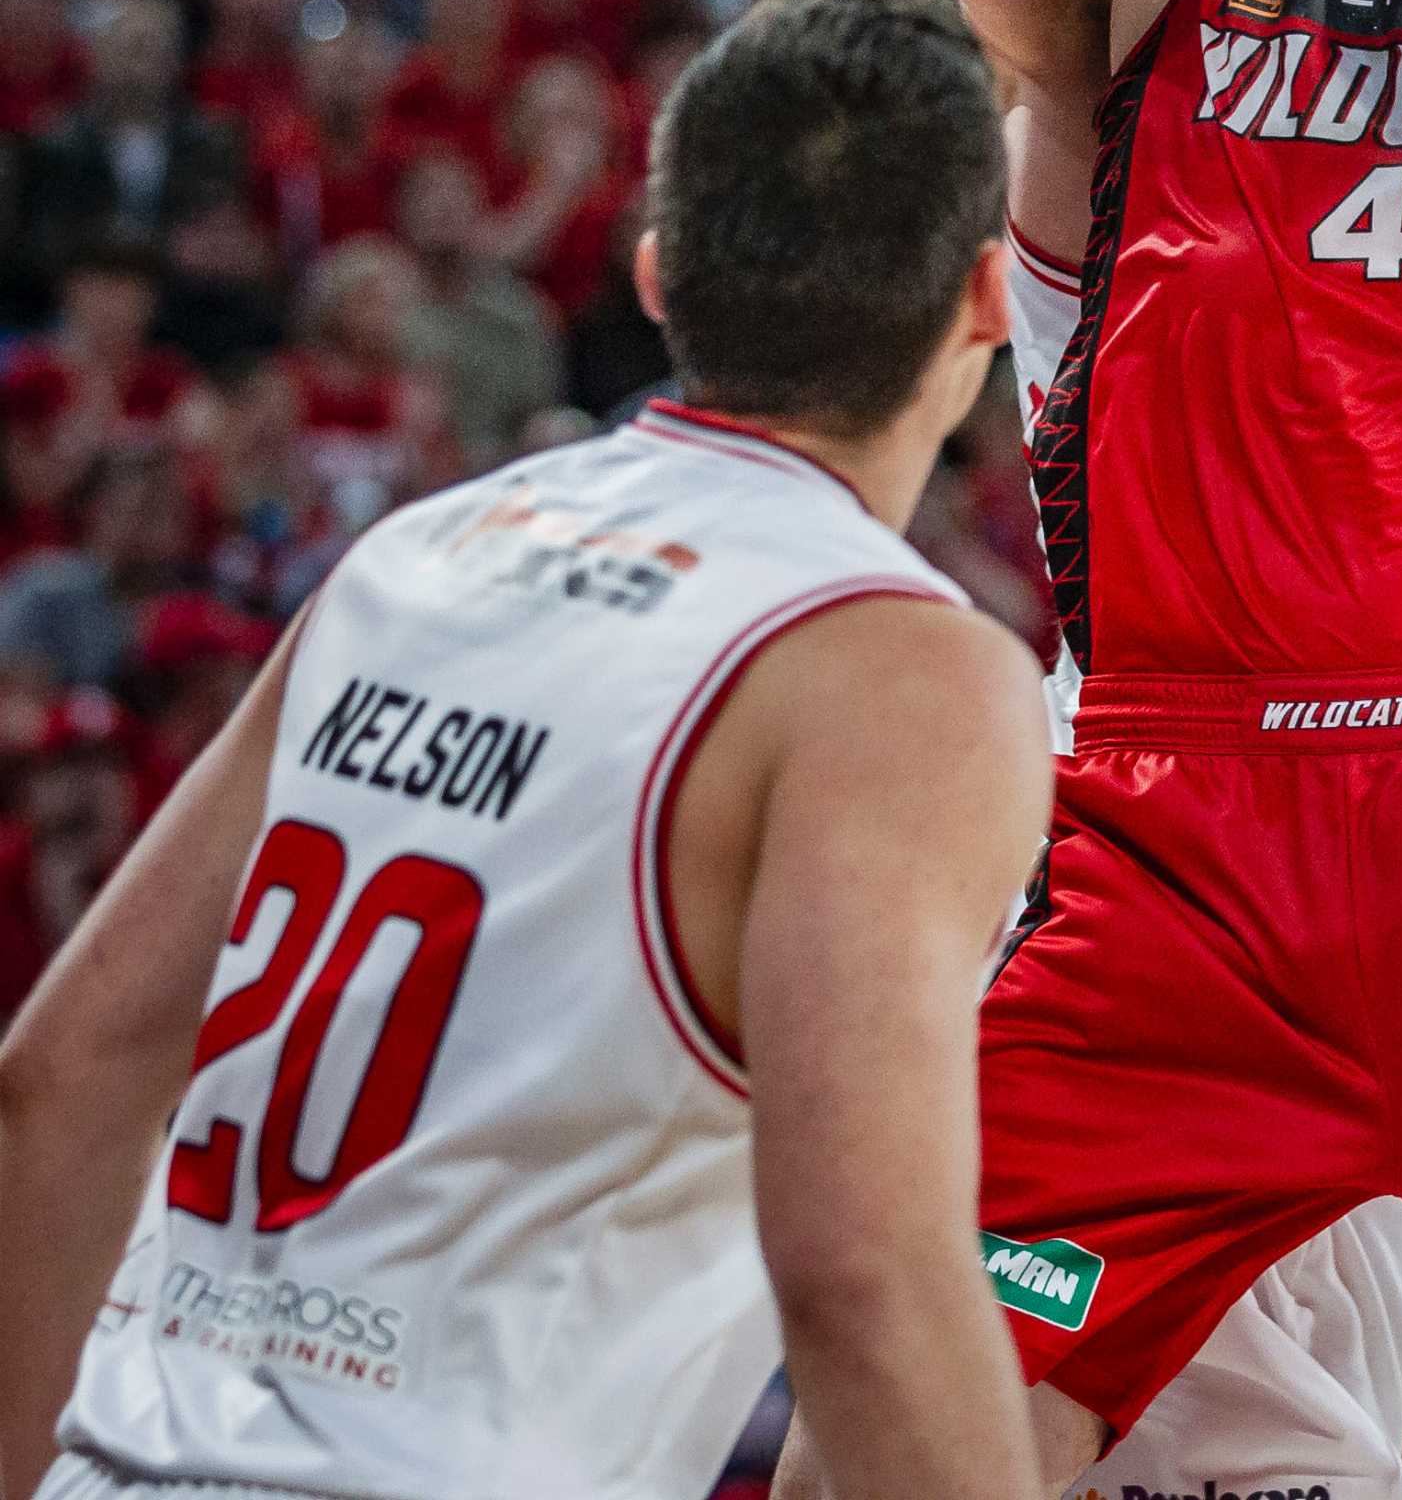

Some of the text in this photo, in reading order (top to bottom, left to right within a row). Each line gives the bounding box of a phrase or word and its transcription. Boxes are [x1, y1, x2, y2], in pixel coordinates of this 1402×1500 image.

[301, 676, 551, 822] NELSON
[166, 818, 487, 1235] 20
[982, 1248, 1080, 1306] MAN
